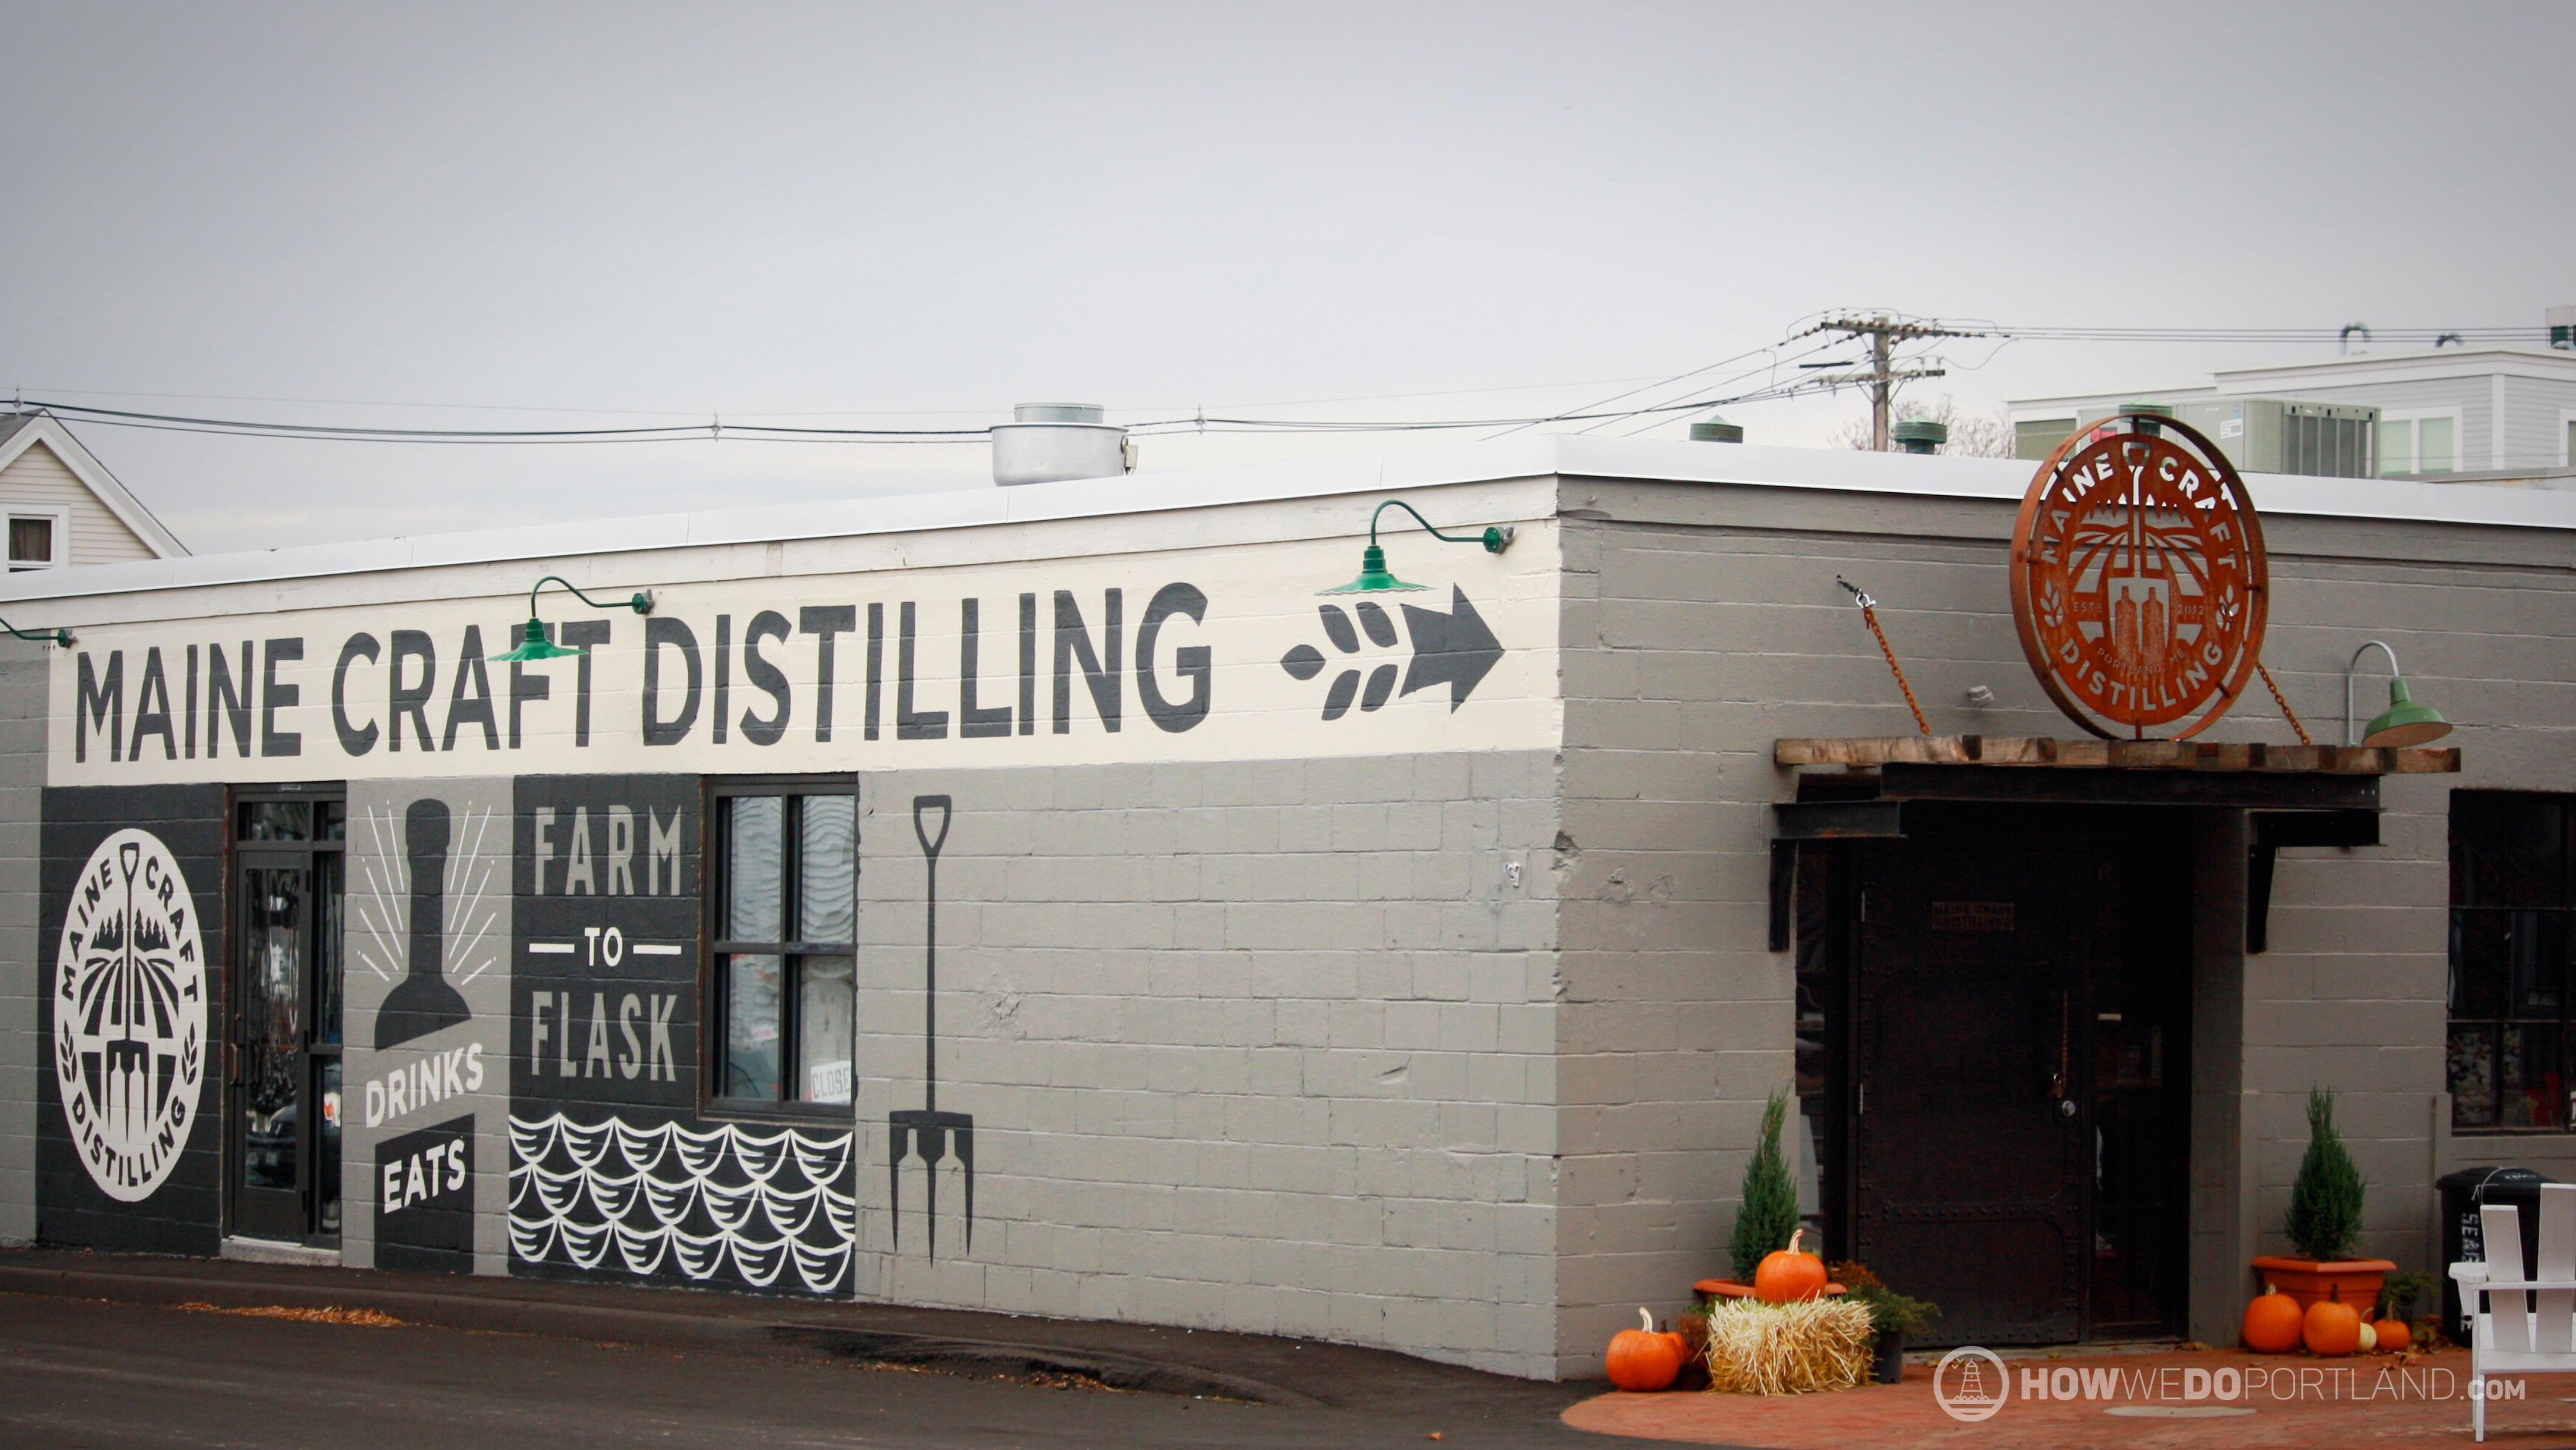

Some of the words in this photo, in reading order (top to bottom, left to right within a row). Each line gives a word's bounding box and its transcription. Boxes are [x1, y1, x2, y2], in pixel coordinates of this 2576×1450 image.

[2041, 452, 2114, 565] MAINE
[2159, 456, 2236, 569] CRAFT
[2178, 604, 2204, 615] 2012
[76, 636, 304, 763] MAINE
[331, 620, 611, 757] CRAFT
[641, 582, 1212, 746] DISTILLING
[2059, 637, 2222, 711] DISTILLING
[535, 804, 681, 896] FARM
[62, 858, 112, 1002] MAINE
[145, 856, 198, 1003] CRAFT
[585, 926, 623, 967] TO
[532, 992, 677, 1082] FLASK
[366, 1042, 483, 1128] DRINKS
[72, 1092, 186, 1188] DISTILLING
[384, 1138, 466, 1215] EATS
